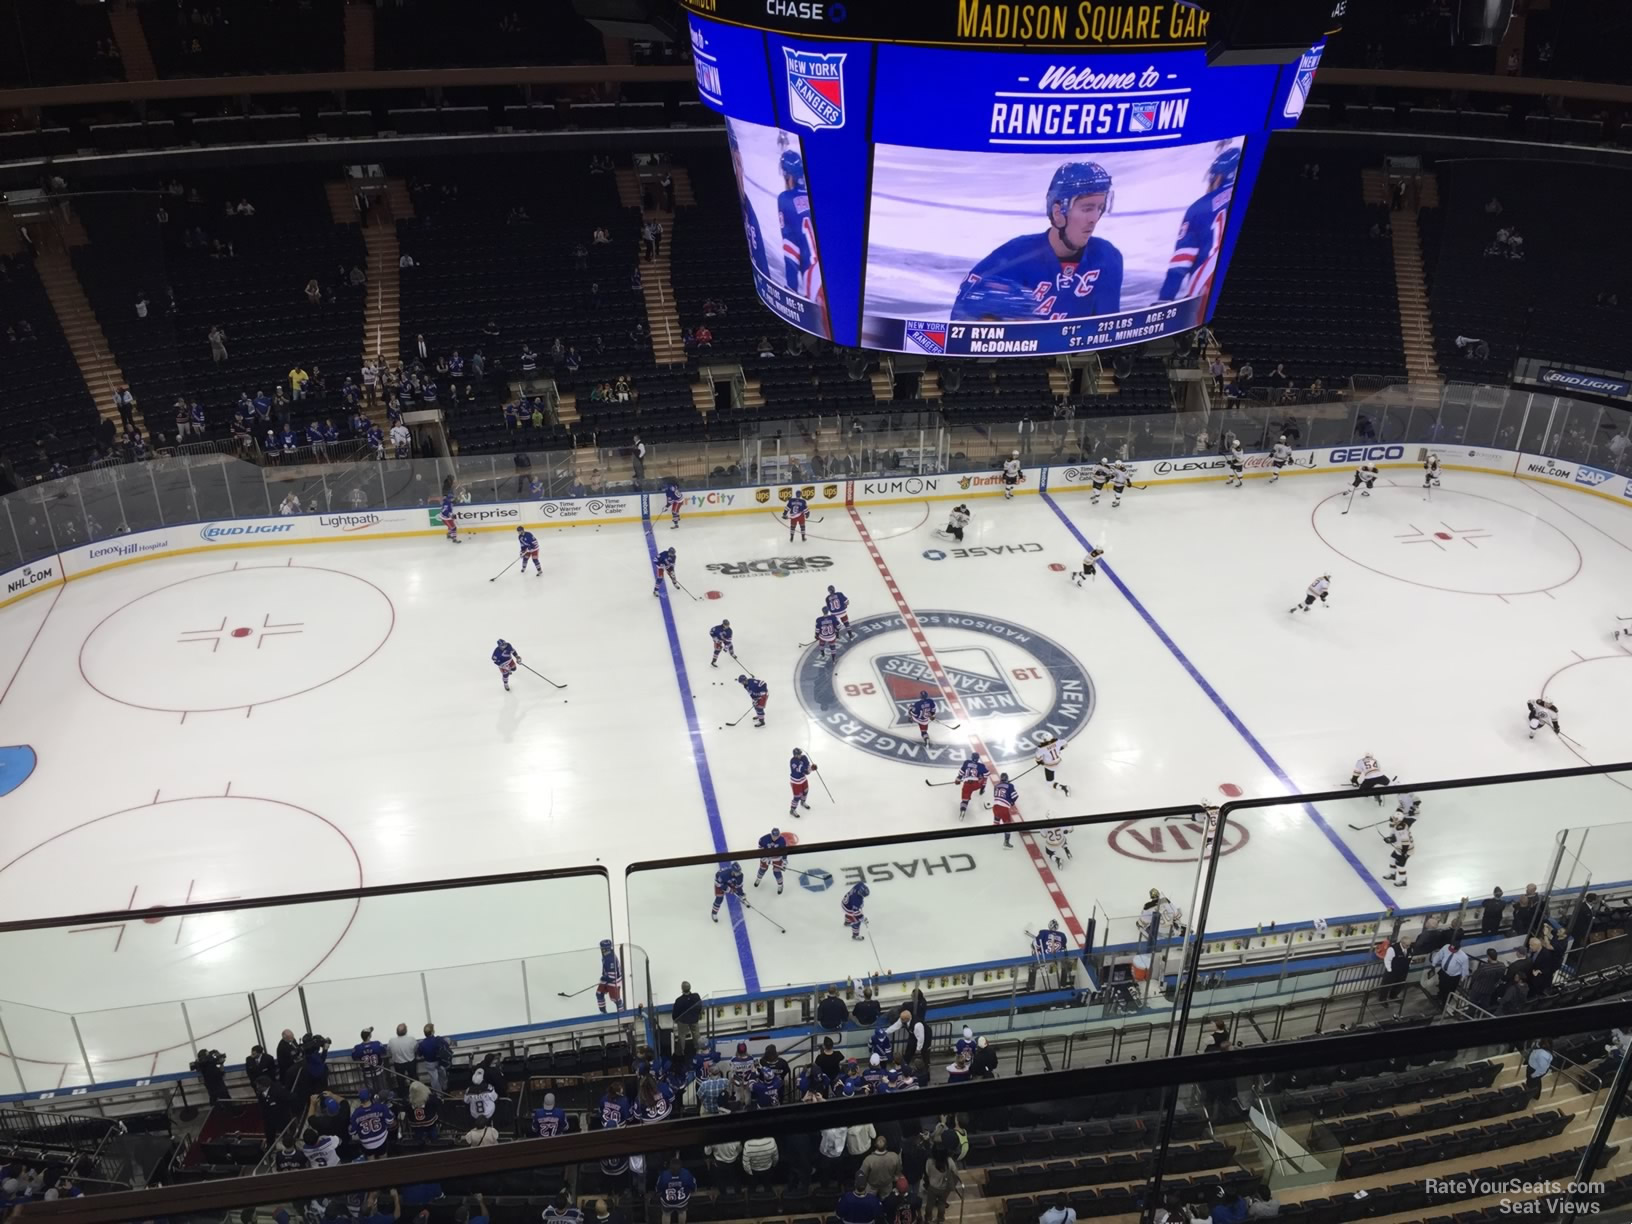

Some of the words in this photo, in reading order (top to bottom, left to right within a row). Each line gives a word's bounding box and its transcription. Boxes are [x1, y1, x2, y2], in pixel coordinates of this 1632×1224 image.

[766, 0, 824, 20] CHASE
[957, 0, 1068, 39] MADISON
[1075, 1, 1164, 42] SQUARE
[1169, 2, 1210, 38] GAR
[789, 58, 807, 73] NEW
[809, 62, 839, 76] YORK
[1038, 65, 1135, 91] Welcome
[1138, 65, 1160, 88] to
[795, 78, 839, 123] RANGERS
[907, 321, 926, 330] NEW
[926, 322, 946, 331] YORK
[1097, 321, 1115, 332] 213
[1115, 317, 1133, 329] LBS
[1145, 311, 1165, 323] AGE:
[1166, 308, 1177, 319] 26
[951, 327, 965, 339] 27
[970, 327, 1005, 339] RYAN
[1069, 337, 1085, 347] ST.
[1086, 333, 1113, 346] PAUL,
[1114, 322, 1165, 341] MINNESOTA
[911, 331, 943, 354] RANGERS
[970, 340, 1039, 352] McDONAGH
[1548, 372, 1582, 386] BUD
[1582, 377, 1623, 393] LIGHT
[1329, 445, 1405, 464] GEICO
[1173, 460, 1226, 472] LEXUS
[1527, 463, 1571, 479] NHL.COM
[1576, 468, 1606, 484] SAP
[802, 489, 815, 499] ups
[824, 487, 837, 497] ups
[864, 478, 937, 495] KUMON
[756, 492, 770, 502] ups
[779, 491, 792, 500] ups
[319, 513, 379, 529] Lightpath
[454, 507, 518, 521] terprise
[206, 524, 243, 537] BUD
[244, 523, 295, 535] LIGHT
[89, 545, 119, 560] Lenox
[118, 542, 138, 556] Hill
[139, 540, 168, 552] Hospital
[950, 543, 1044, 558] CHASE
[8, 567, 53, 593] NHL.COM
[947, 616, 1032, 644] MADISON
[1011, 667, 1044, 681] 19
[843, 683, 877, 697] 26
[966, 693, 1016, 711] NEW
[1057, 679, 1084, 720] NEW
[827, 712, 967, 761] RANGERS
[1049, 750, 1059, 761] 11
[1047, 828, 1062, 842] 25
[841, 852, 977, 886] CHASE
[360, 1119, 382, 1135] 36
[540, 1124, 558, 1137] 27
